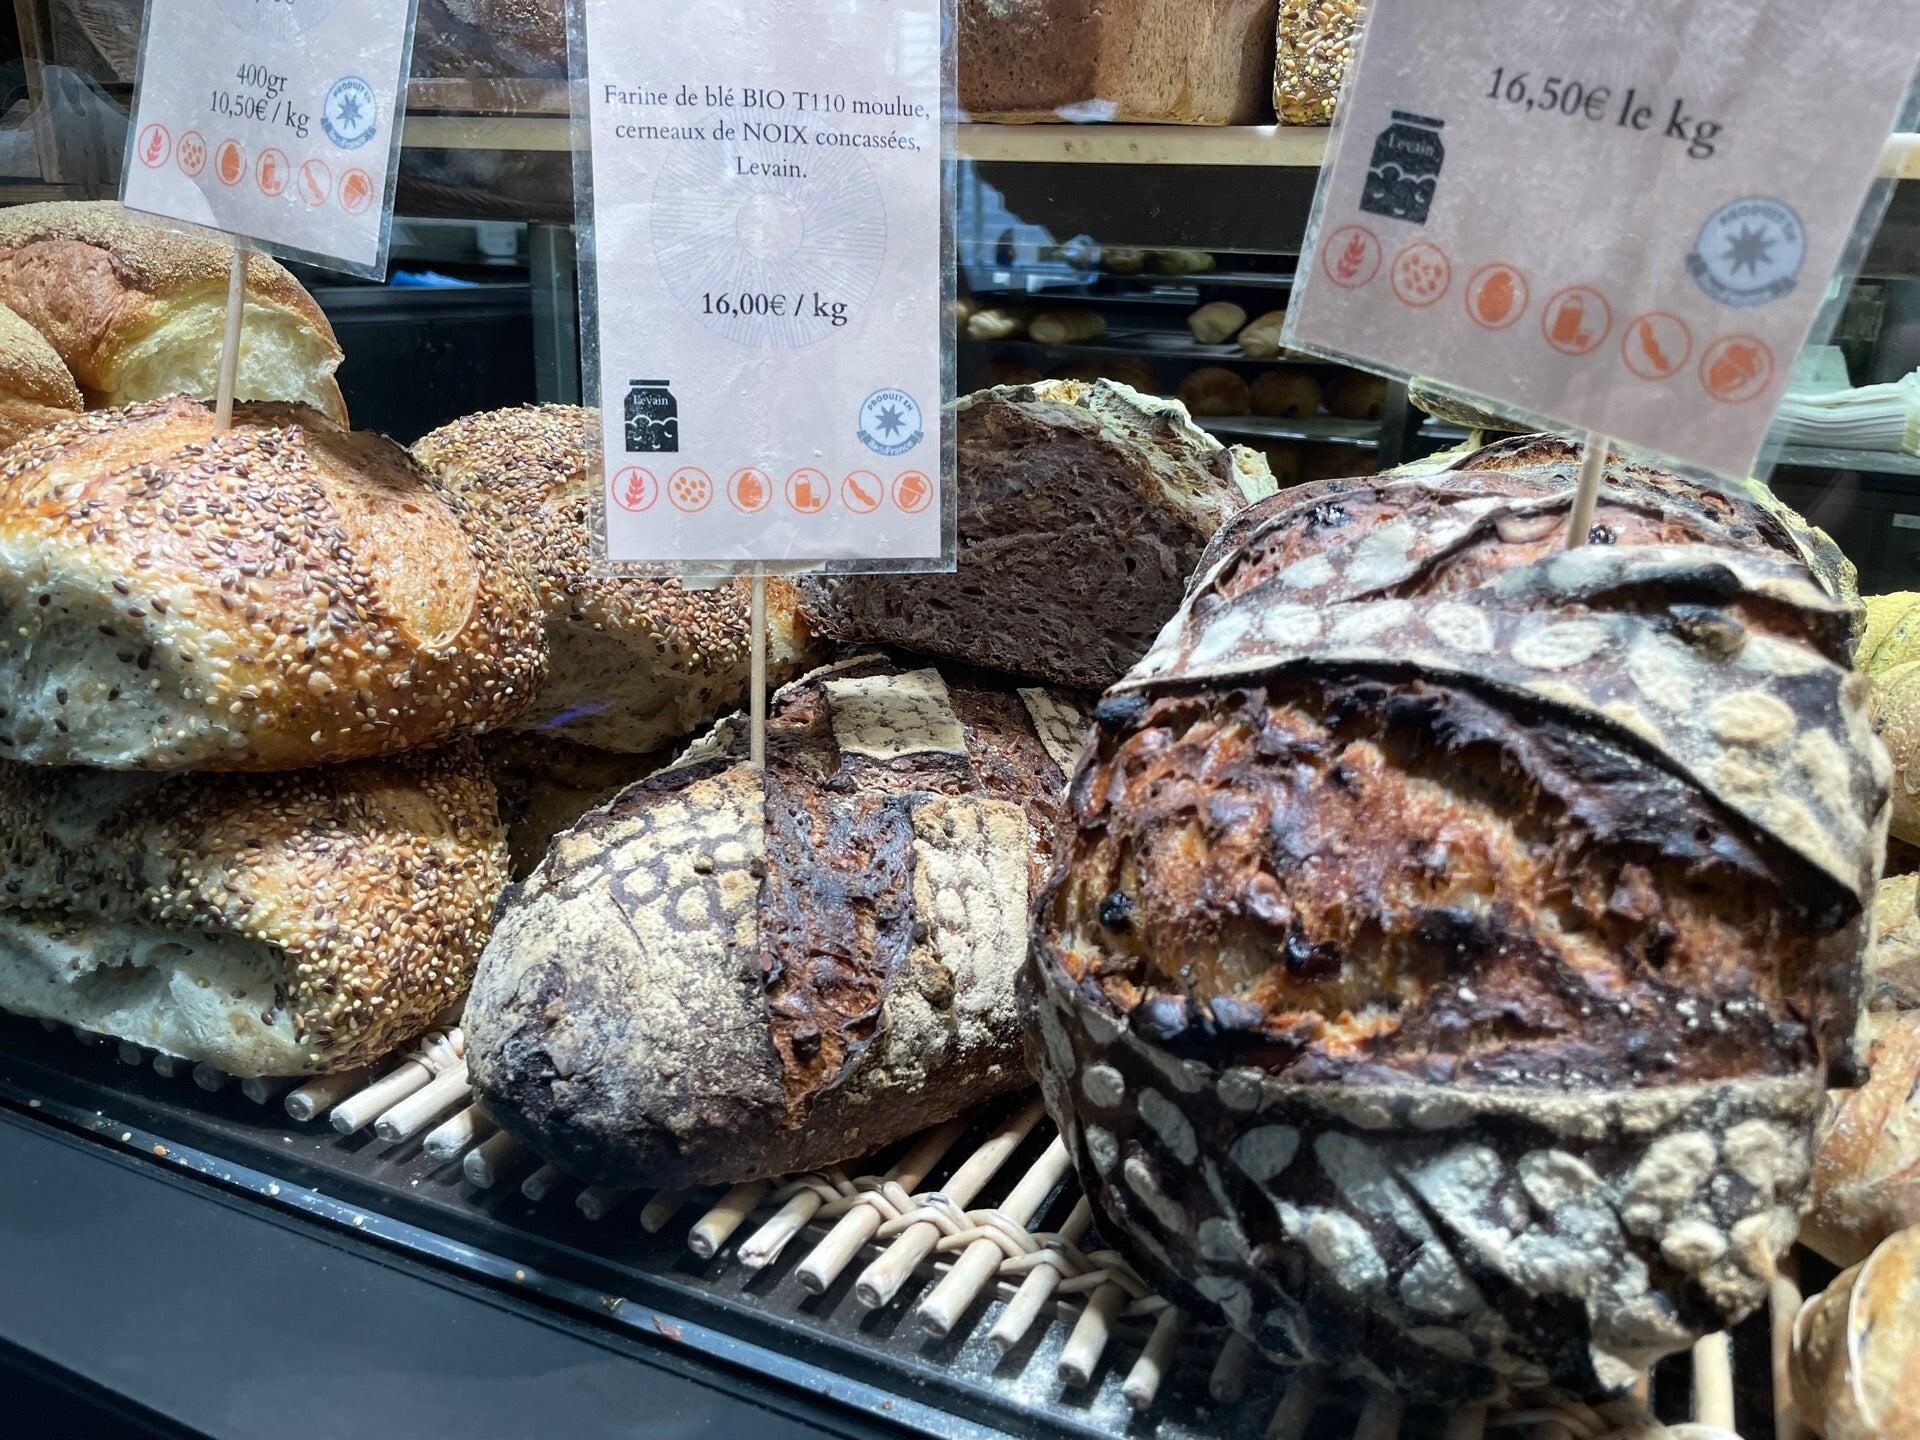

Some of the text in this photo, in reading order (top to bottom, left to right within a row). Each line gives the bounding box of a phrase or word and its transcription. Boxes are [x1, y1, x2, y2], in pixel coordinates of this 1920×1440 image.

[237, 63, 288, 99] 400gr
[211, 90, 268, 121] 10,50€
[271, 101, 281, 123] /
[285, 101, 310, 138] kg
[604, 85, 930, 119] Farine de blé BIO T110 moulue,
[1486, 67, 1722, 160] 16,50€ le kg
[615, 120, 921, 152] cerneaux de NOIX concassées,
[737, 156, 807, 178] Levain.
[702, 292, 848, 327] 16,00€ / kg
[867, 393, 914, 411] PRODUIT EN
